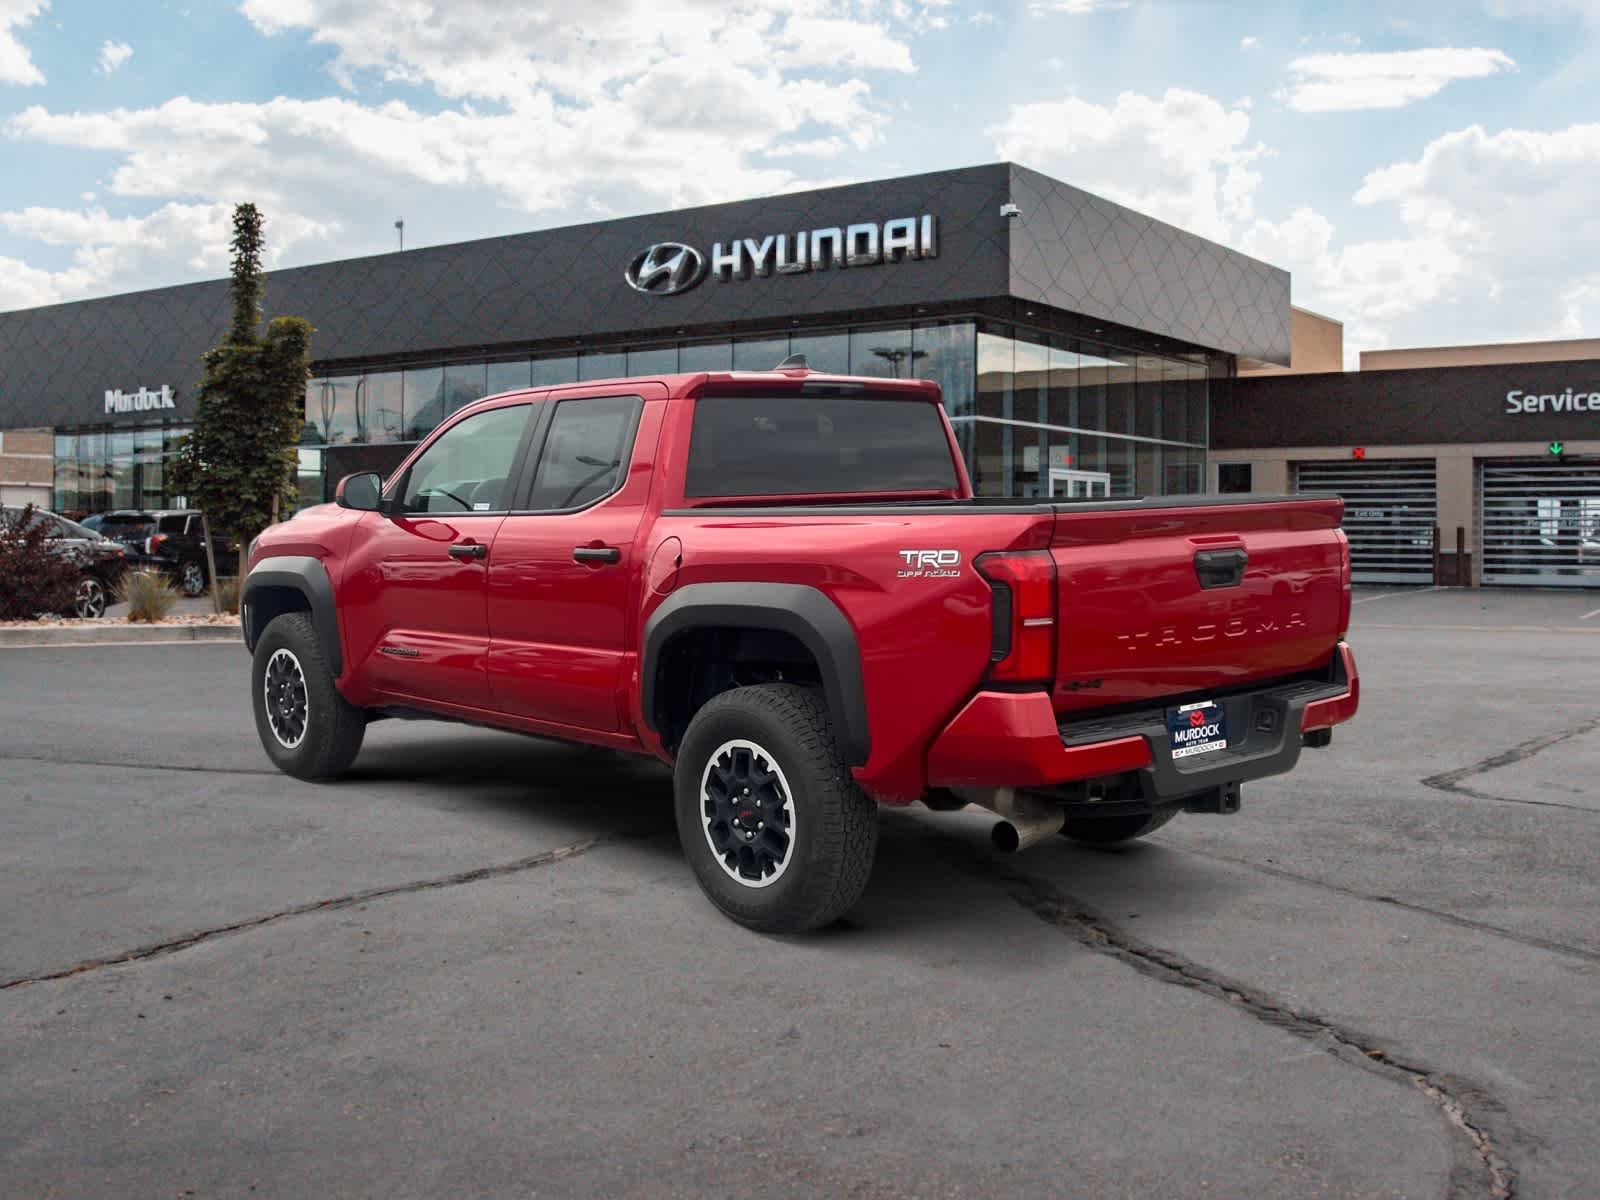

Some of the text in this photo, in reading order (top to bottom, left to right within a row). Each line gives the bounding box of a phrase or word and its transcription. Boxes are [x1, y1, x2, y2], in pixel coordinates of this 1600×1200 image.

[712, 213, 937, 281] HYUNDAI
[104, 384, 176, 414] Murdock
[1505, 387, 1600, 414] Service
[899, 549, 960, 569] TRD
[1117, 612, 1306, 650] TACOMA
[1174, 722, 1220, 743] MURDOCK
